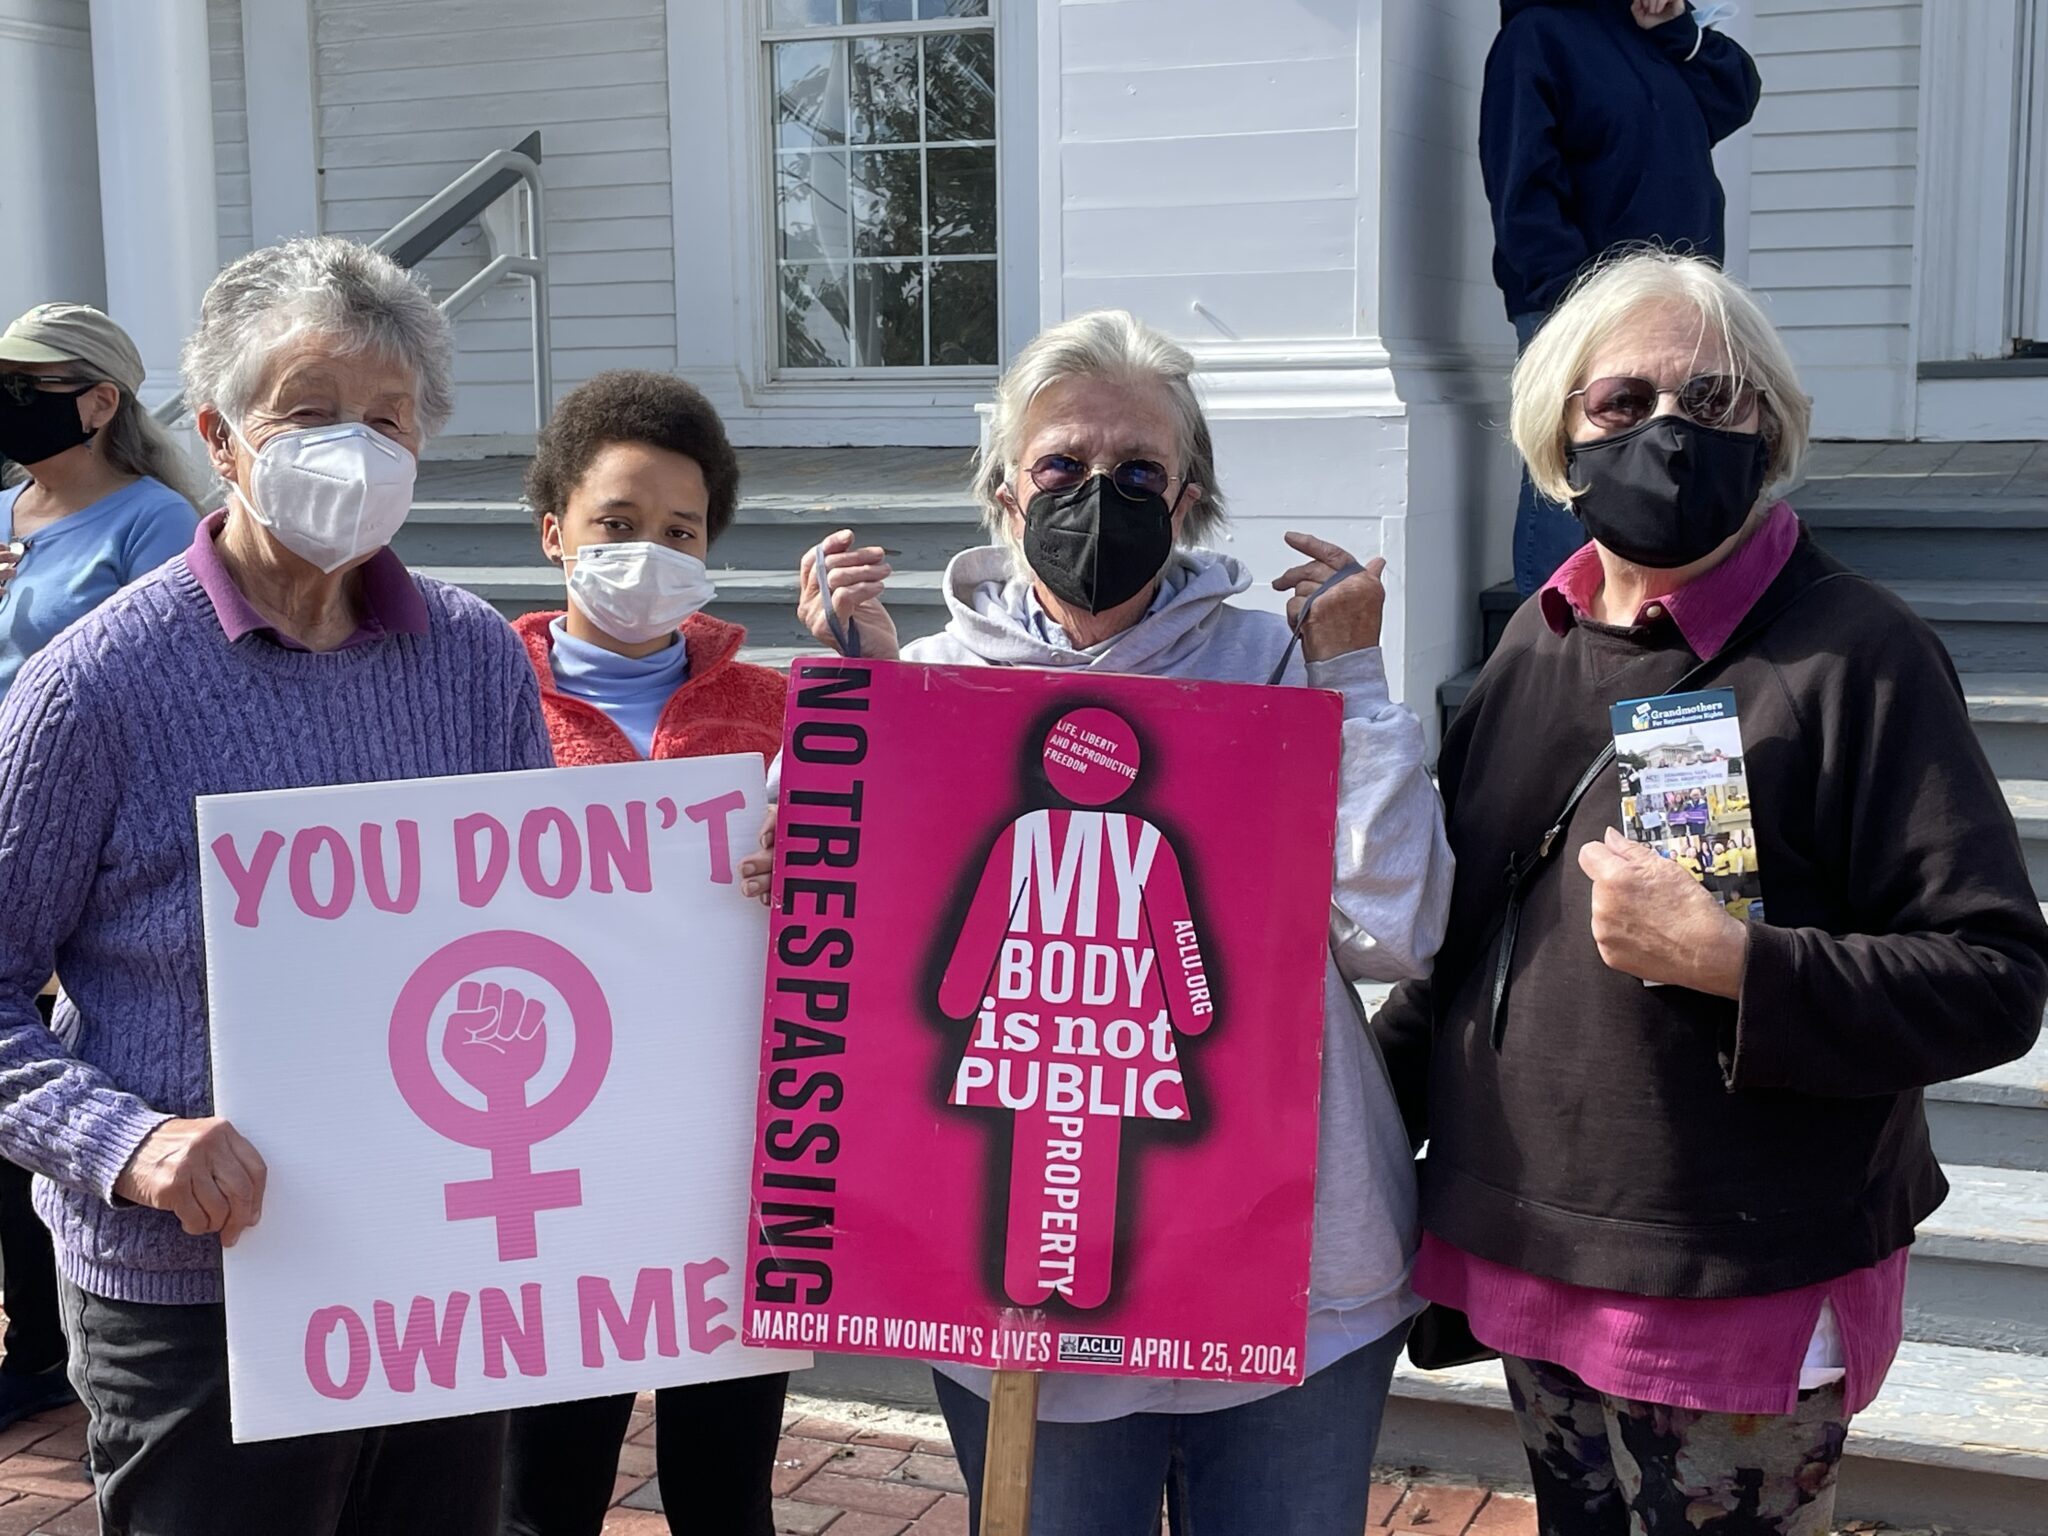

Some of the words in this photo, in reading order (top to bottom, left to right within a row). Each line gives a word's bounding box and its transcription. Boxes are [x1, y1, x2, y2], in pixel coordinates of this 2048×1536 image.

[793, 667, 872, 765] NO
[1056, 720, 1078, 739] LIFE,
[1080, 730, 1118, 754] LIBERTY
[1651, 702, 1723, 719] Grandmothers
[1704, 710, 1724, 720] Rights
[1044, 747, 1088, 774] FREEDOM
[1050, 734, 1070, 749] AND
[1070, 742, 1138, 779] REPRODUCTIVE
[211, 820, 421, 928] YOU
[454, 790, 746, 907] DON'T
[1009, 809, 1162, 941] MY
[998, 938, 1155, 1009] BODY
[1173, 919, 1213, 1017] ACLU.ORG
[756, 780, 864, 1304] TRESPASSING
[974, 996, 1040, 1052] is
[1052, 1009, 1178, 1063] not
[954, 1056, 1185, 1120] PUBLIC
[1038, 1115, 1085, 1297] PROPERTY
[304, 1283, 548, 1400] OWN
[578, 1257, 737, 1368] ME
[751, 1309, 829, 1343] MARCH
[837, 1315, 878, 1347] FOR
[884, 1318, 984, 1357] WOMEN'S
[991, 1328, 1051, 1363] LIVES
[1079, 1338, 1122, 1354] ACLU
[1130, 1337, 1195, 1370] APRIL
[1201, 1341, 1233, 1374] 25,
[1240, 1344, 1297, 1376] 2004
